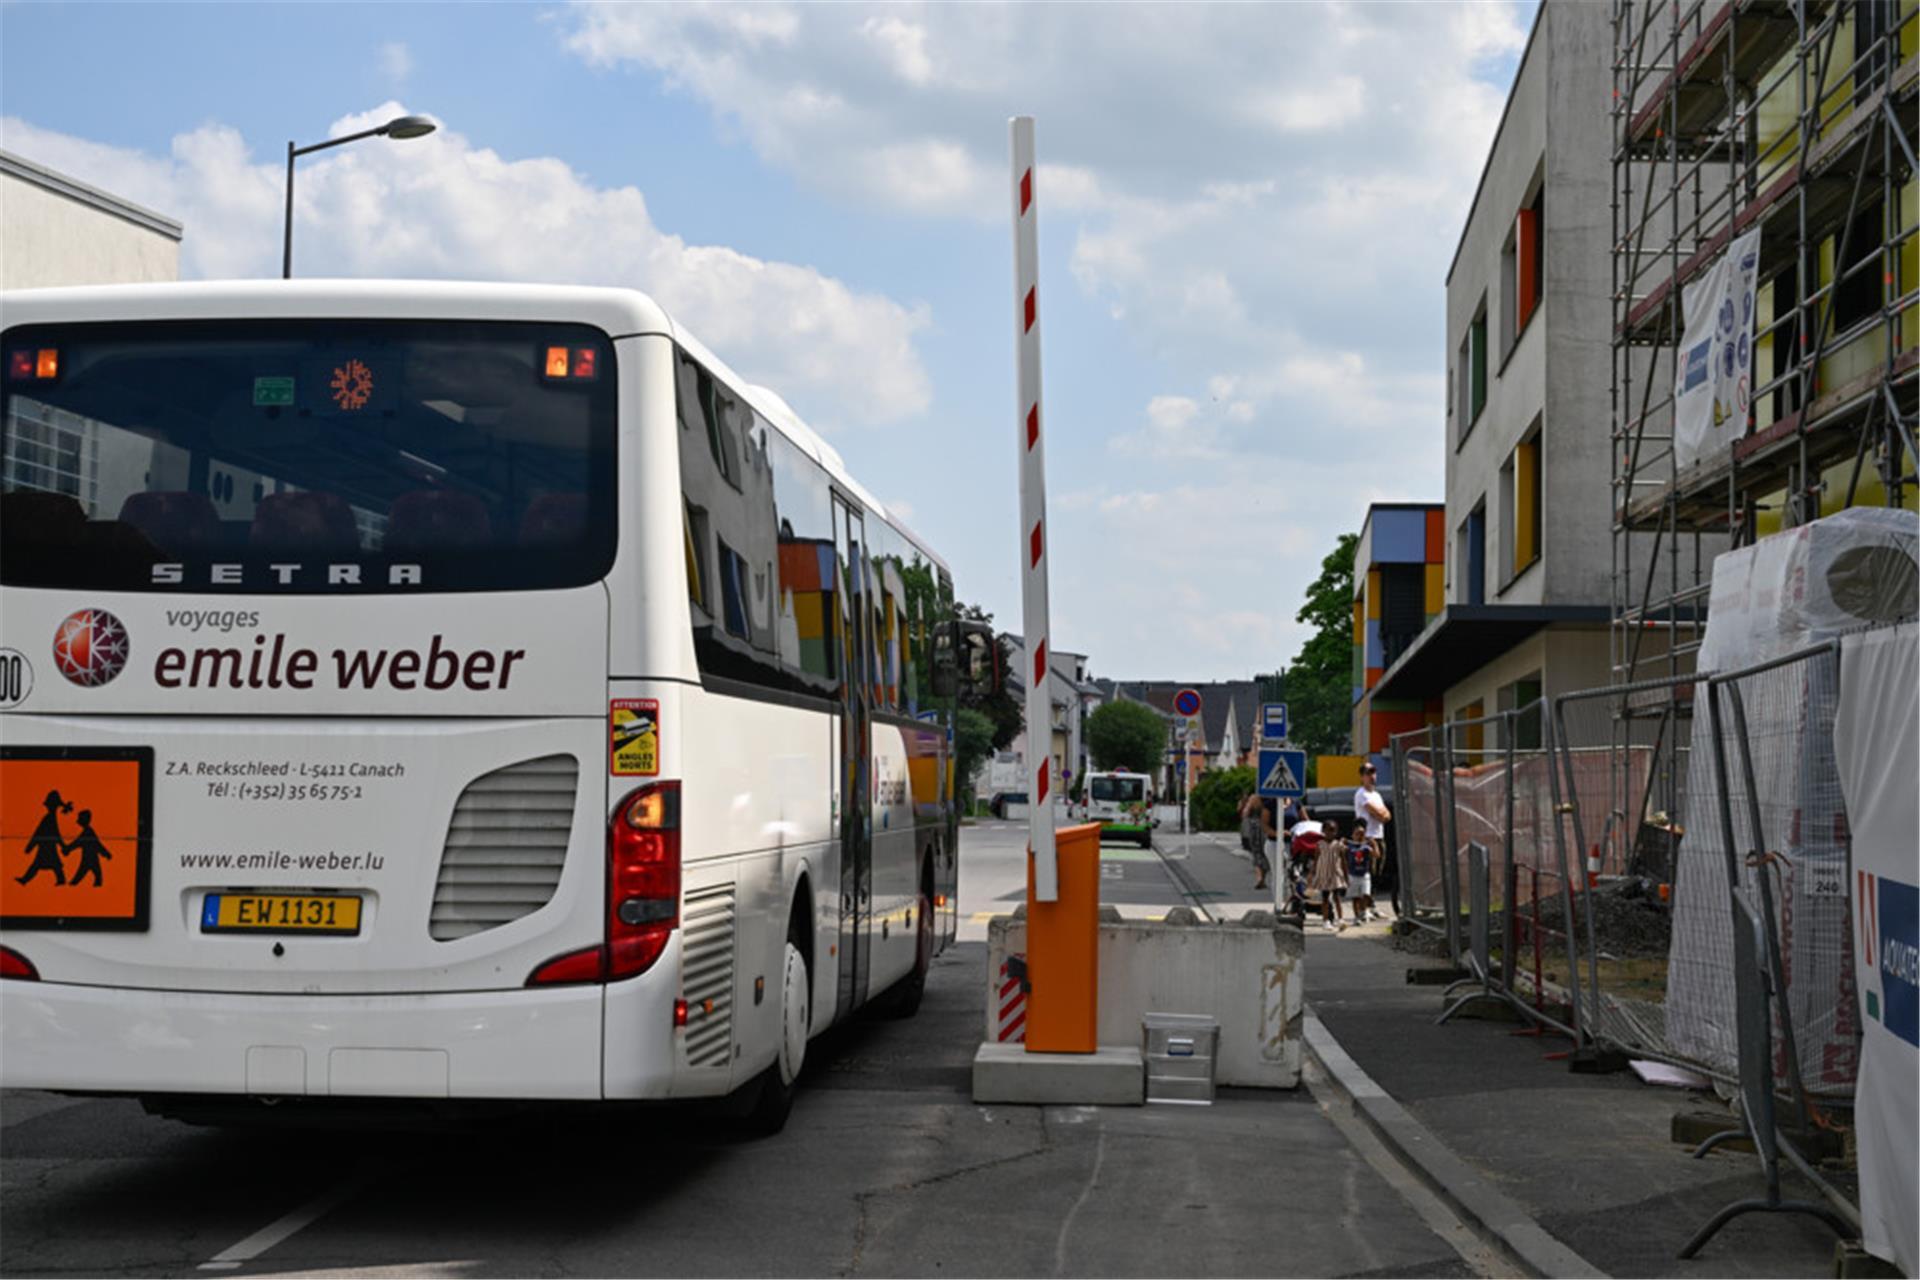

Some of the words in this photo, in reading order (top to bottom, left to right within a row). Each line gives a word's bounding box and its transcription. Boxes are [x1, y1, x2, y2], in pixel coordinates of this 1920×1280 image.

[151, 564, 422, 585] SETRA
[166, 608, 260, 632] voyages
[153, 632, 319, 689] emile
[331, 634, 526, 692] weber
[165, 761, 192, 776] Z.A.
[196, 761, 290, 777] Reckschleed
[299, 762, 345, 778] L-5411
[349, 762, 405, 777] Canach
[238, 782, 285, 800] (+352)
[288, 785, 306, 800] 35
[309, 783, 328, 800] 65
[180, 851, 385, 871] www.emile-weber.lu
